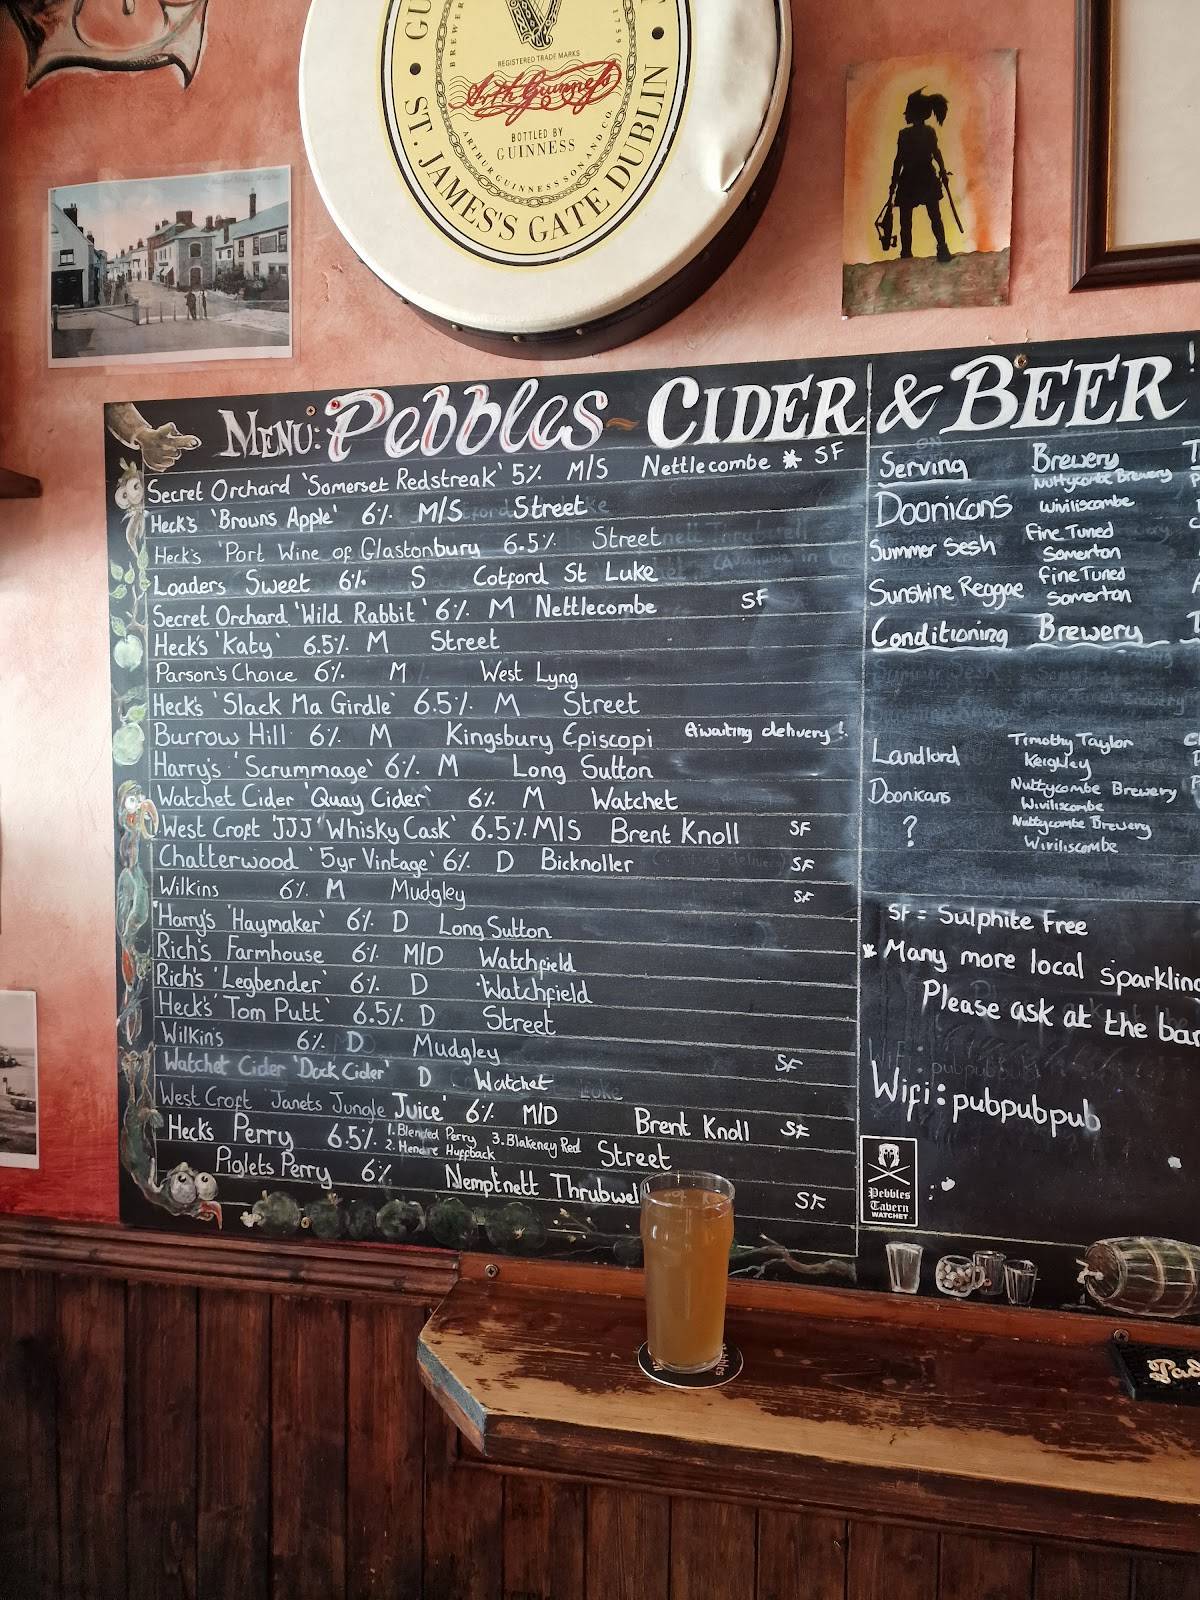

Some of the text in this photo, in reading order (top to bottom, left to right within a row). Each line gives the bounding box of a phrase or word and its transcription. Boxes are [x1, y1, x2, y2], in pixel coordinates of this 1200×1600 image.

[498, 50, 581, 68] REGISTERED TRADE MARKS
[497, 138, 575, 160] GUINNESS
[511, 128, 563, 142] BOTTLED BY
[418, 151, 518, 240] JAMES'S
[529, 187, 610, 242] GATE
[605, 63, 669, 193] DUBLIN
[463, 130, 494, 175] ARTHUR
[495, 175, 560, 193] GUINNESS
[563, 161, 584, 183] SON
[587, 133, 603, 158] AND
[325, 378, 609, 463] Pebbles
[647, 374, 866, 449] CIDER
[876, 374, 944, 434] &
[147, 441, 845, 504] Secret Orchard Nettlecombe SF
[879, 442, 1120, 479] Serving Brewery
[1116, 468, 1173, 484] Brewery
[513, 495, 588, 519] Street
[875, 491, 1013, 527] Doonicans
[154, 549, 202, 566] Heck's
[278, 542, 319, 562] Wine
[333, 545, 352, 564] of
[360, 537, 481, 561] Glastonbury
[592, 526, 662, 550] Street
[1025, 521, 1114, 541] Fine Tuned
[869, 535, 996, 562] Summer Sesh
[1042, 546, 1121, 562] Somerton
[153, 562, 659, 597] Loaders Sweet Cotford St Luke
[1038, 566, 1125, 586] Fine Tuned
[152, 589, 769, 628] Secret Orchard M Nettlecombe SF
[869, 576, 1024, 610] Sunshine Reggae
[1047, 588, 1132, 608] Somerton
[154, 629, 500, 657] Heck's M Street
[871, 613, 1143, 648] Conditioning Brewery
[156, 660, 578, 690] Parson's Choice M West Lyng
[153, 691, 640, 717] Heck's Ma M Street
[155, 721, 753, 753] Burrow Hill M Kingsbury Episcopi Awaiting
[871, 738, 960, 766] Landlord
[1008, 733, 1134, 756] Timothy Taylor
[154, 751, 653, 784] Harry's M Long Sutton
[157, 784, 678, 811] Watchet Cider M Watchet
[868, 777, 951, 804] Doonicans
[1011, 777, 1101, 798] Nuttycombe
[1112, 781, 1177, 803] Brewery
[162, 815, 811, 845] West Croft Brent Knoll SF
[902, 816, 917, 847] ?
[1090, 816, 1152, 840] Brewery
[159, 843, 814, 872] Chatterwood D Bicknoller SF
[159, 876, 814, 909] Wilkins M Mudgley SF
[393, 910, 552, 941] D Long Sutton
[888, 904, 1088, 936] SF Sulphite Free
[157, 934, 577, 979] Rich's Farmhouse Watchfield
[884, 940, 947, 973] Many
[960, 950, 1016, 970] more
[1031, 948, 1084, 979] local
[156, 963, 593, 1008] Rich's D Watchfield
[158, 995, 556, 1035] Heck's D Street
[922, 978, 1001, 1019] Please
[1010, 998, 1053, 1027] ask
[1064, 1005, 1092, 1028] at
[1104, 1008, 1147, 1039] the
[164, 1047, 287, 1076] Watchet Cider
[413, 1033, 803, 1073] Mudgley SF
[160, 1081, 750, 1142] West Croft Jungle Brent Knoll
[953, 1087, 1101, 1138] pubpubpub
[233, 1112, 672, 1171] Perry Perry Blakeney Red Street
[216, 1145, 540, 1198] Piglets Perry Nemptnett
[868, 1187, 910, 1199] Pebbles
[870, 1201, 909, 1212] Tavern
